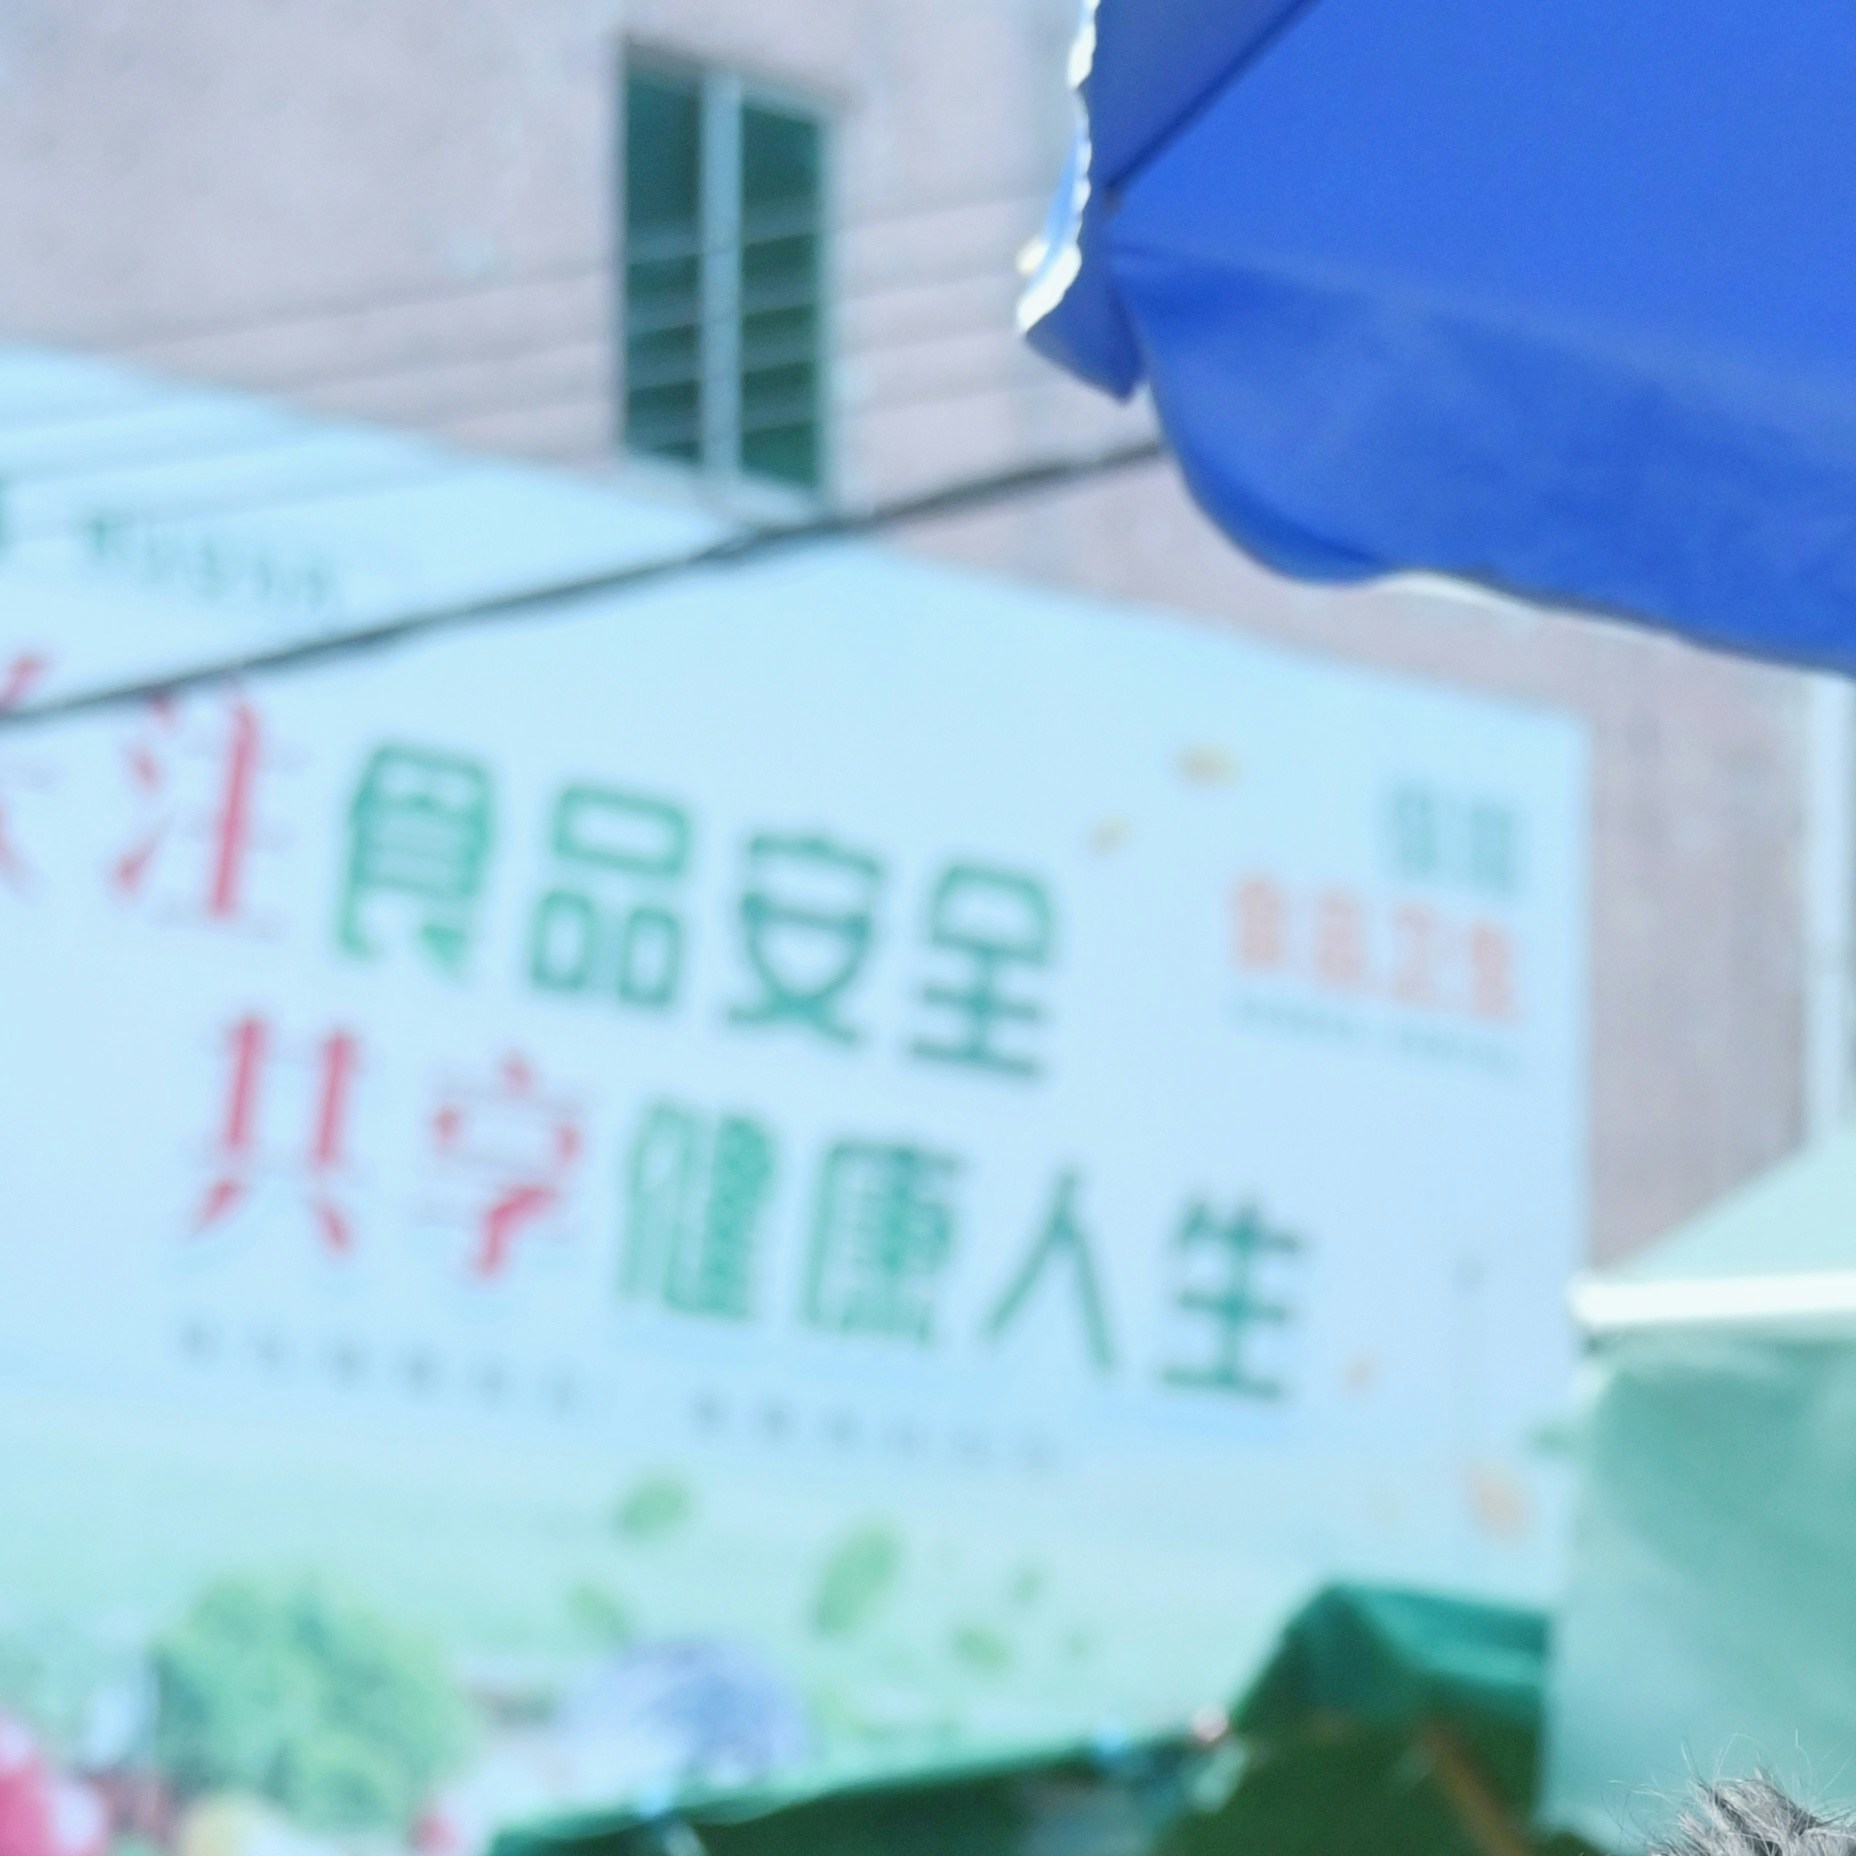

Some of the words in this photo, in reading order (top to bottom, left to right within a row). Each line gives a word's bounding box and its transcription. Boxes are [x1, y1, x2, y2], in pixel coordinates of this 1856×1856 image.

[188, 1010, 1312, 1404] 共享健康人生
